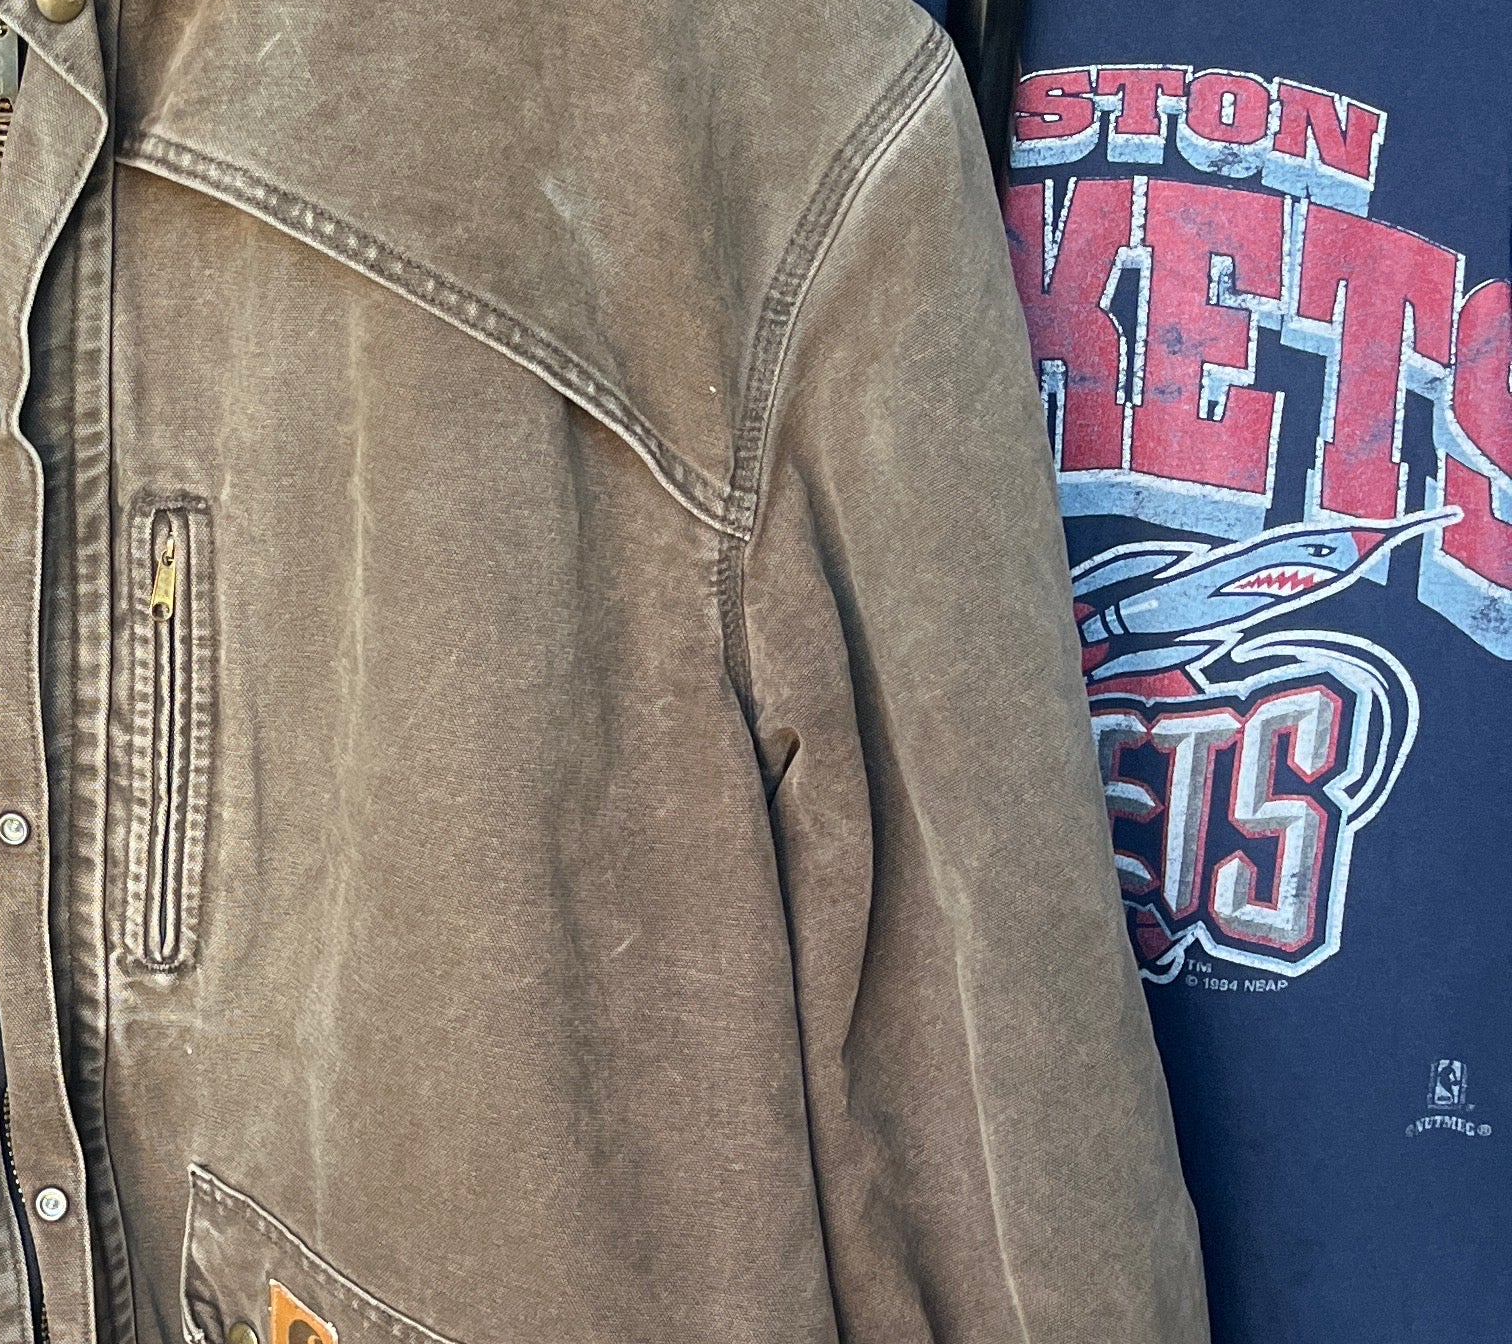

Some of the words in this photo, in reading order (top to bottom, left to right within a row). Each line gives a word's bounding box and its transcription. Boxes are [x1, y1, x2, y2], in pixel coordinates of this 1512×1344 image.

[1010, 64, 1388, 214] STON
[1090, 685, 1343, 954] ETS
[1186, 958, 1213, 974] TM
[1202, 976, 1238, 992] 1994
[1243, 979, 1289, 993] NBAP
[1415, 1115, 1476, 1137] NUTMEG
